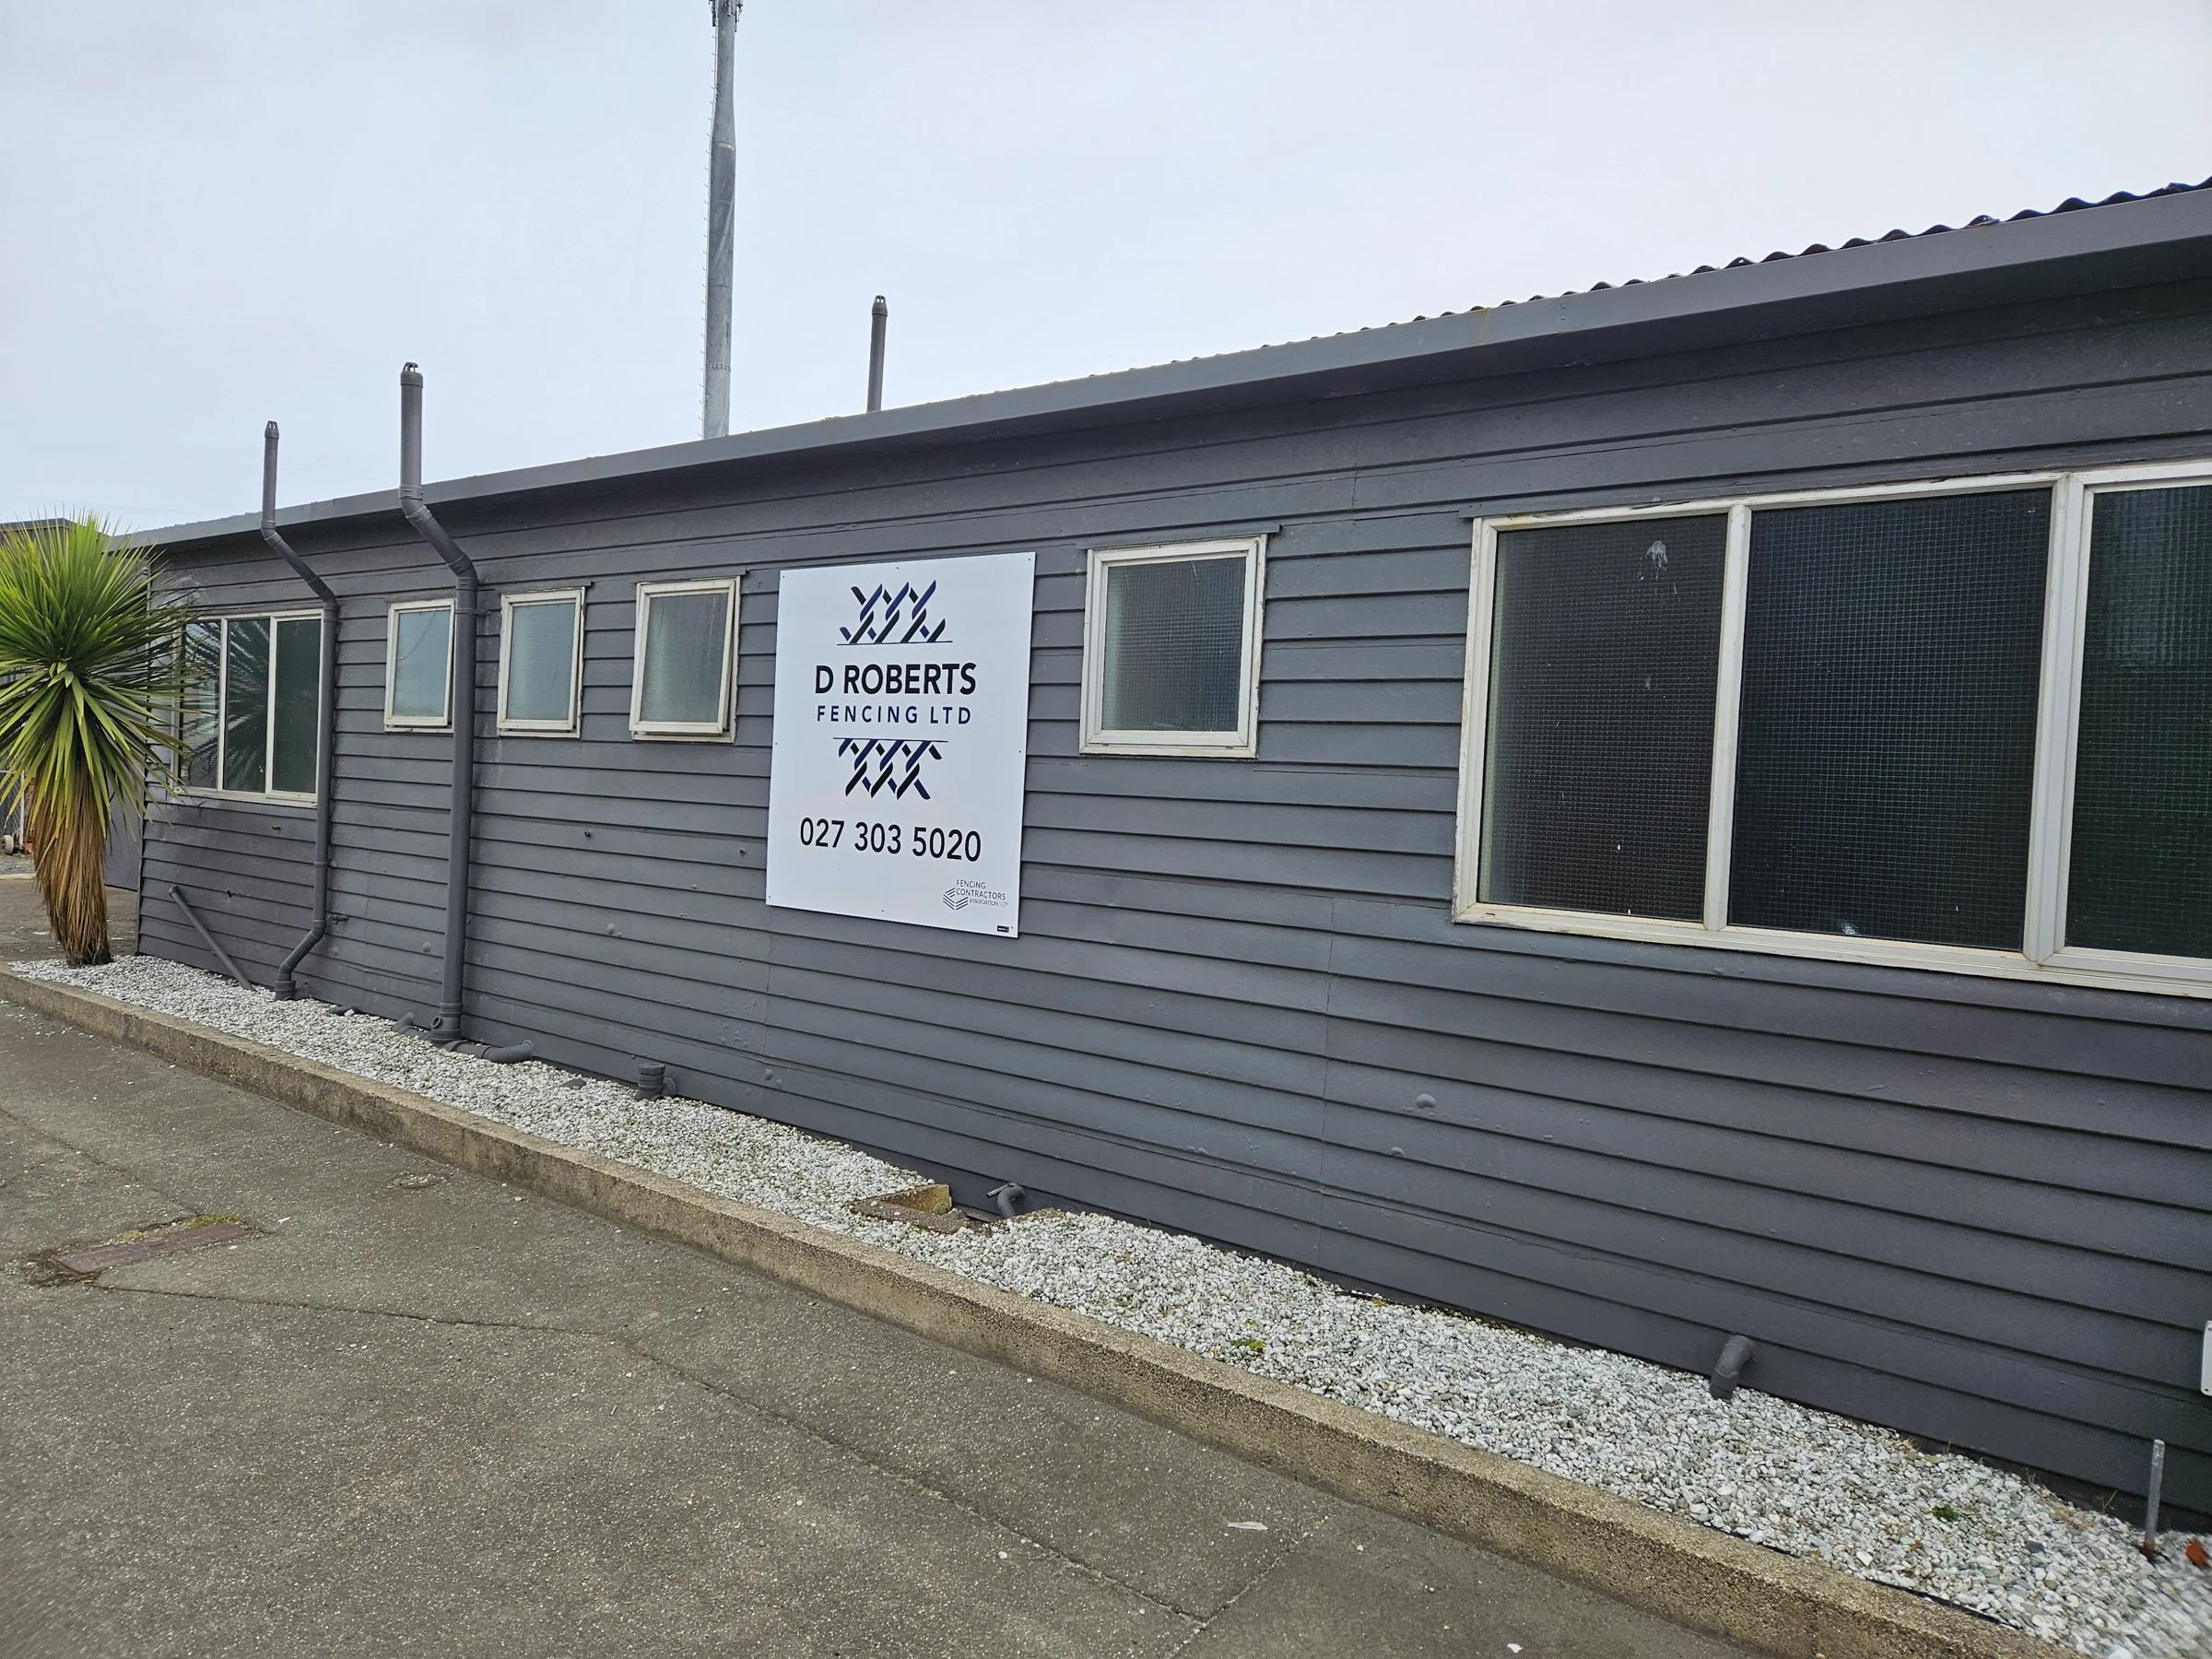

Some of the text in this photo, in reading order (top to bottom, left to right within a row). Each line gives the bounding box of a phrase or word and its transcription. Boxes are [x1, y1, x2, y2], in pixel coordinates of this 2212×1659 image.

[816, 663, 976, 695] D ROBERTS
[818, 705, 971, 725] FENCING LTD
[800, 818, 982, 862] 027 303 5020
[956, 879, 986, 889] FENCING
[956, 888, 1006, 900] CONTRACTORS
